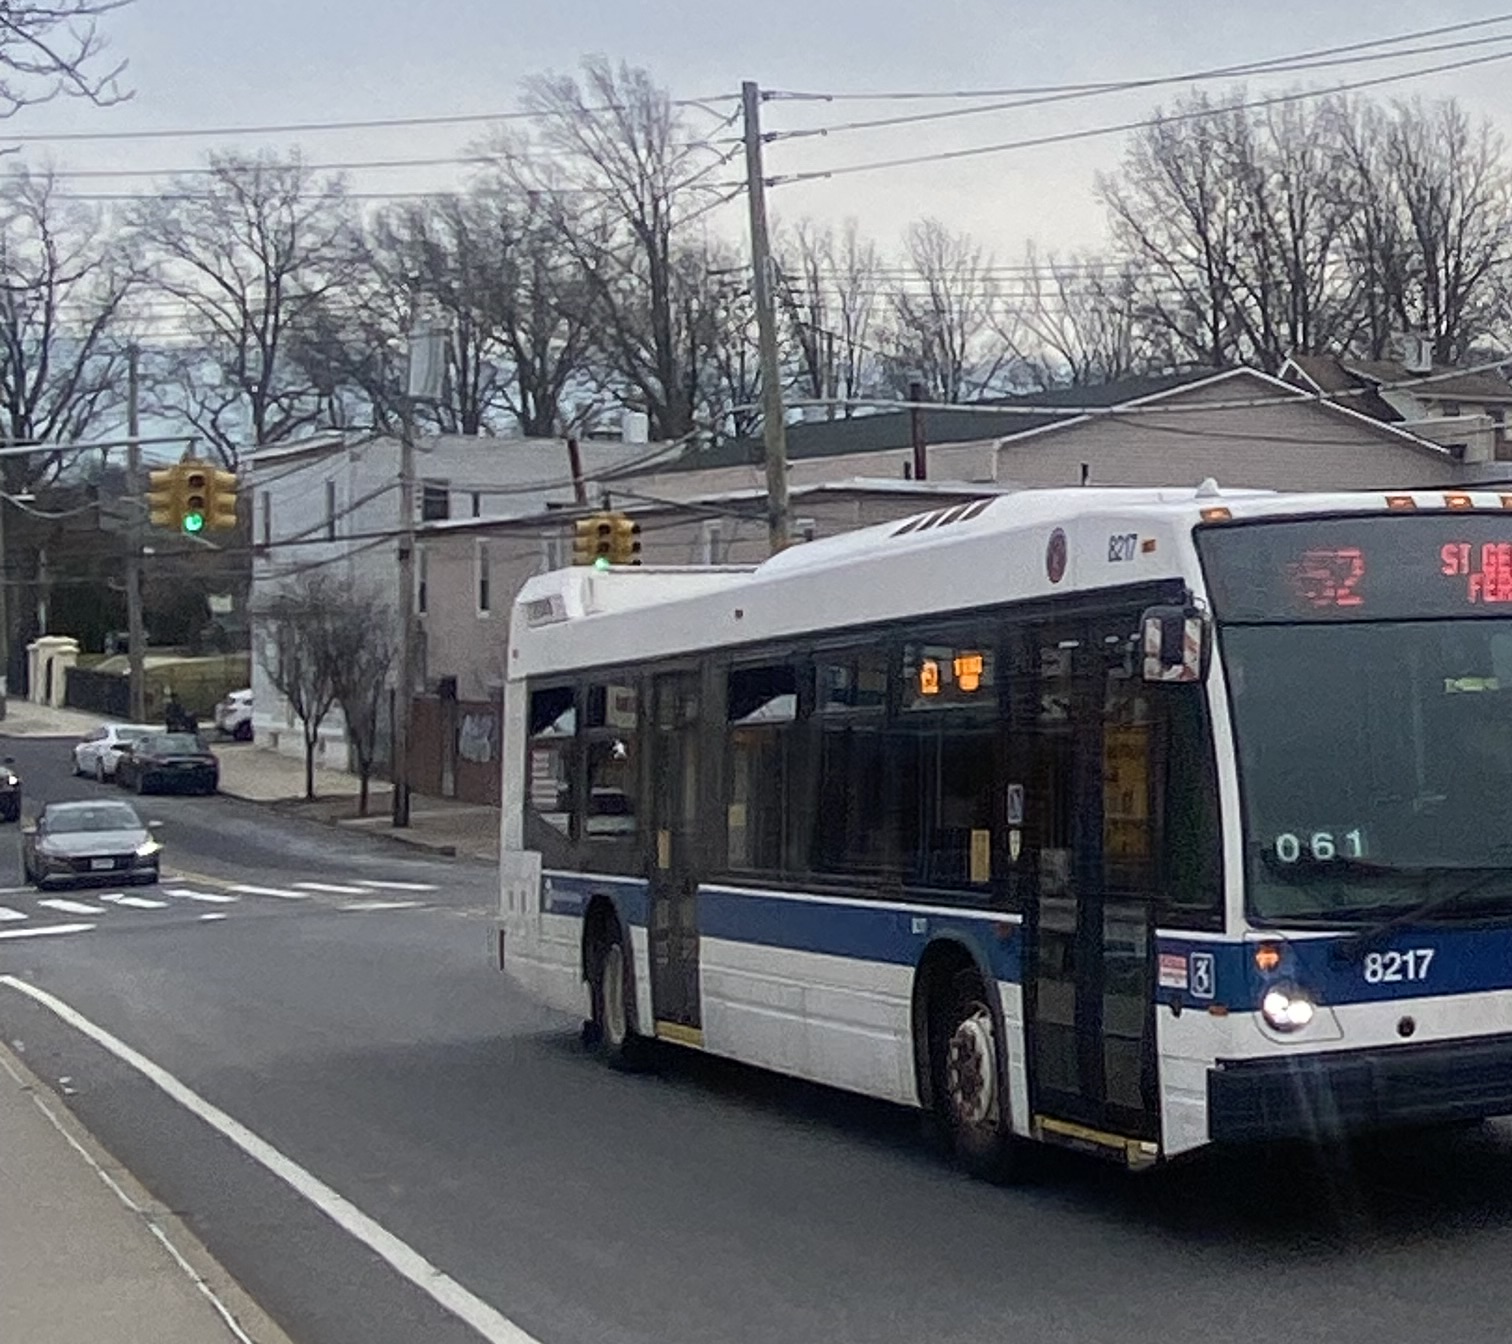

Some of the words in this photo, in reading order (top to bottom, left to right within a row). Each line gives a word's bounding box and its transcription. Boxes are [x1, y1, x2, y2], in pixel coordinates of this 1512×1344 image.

[1440, 543, 1471, 574] ST
[1276, 829, 1362, 862] 061
[1364, 949, 1434, 983] 8217
